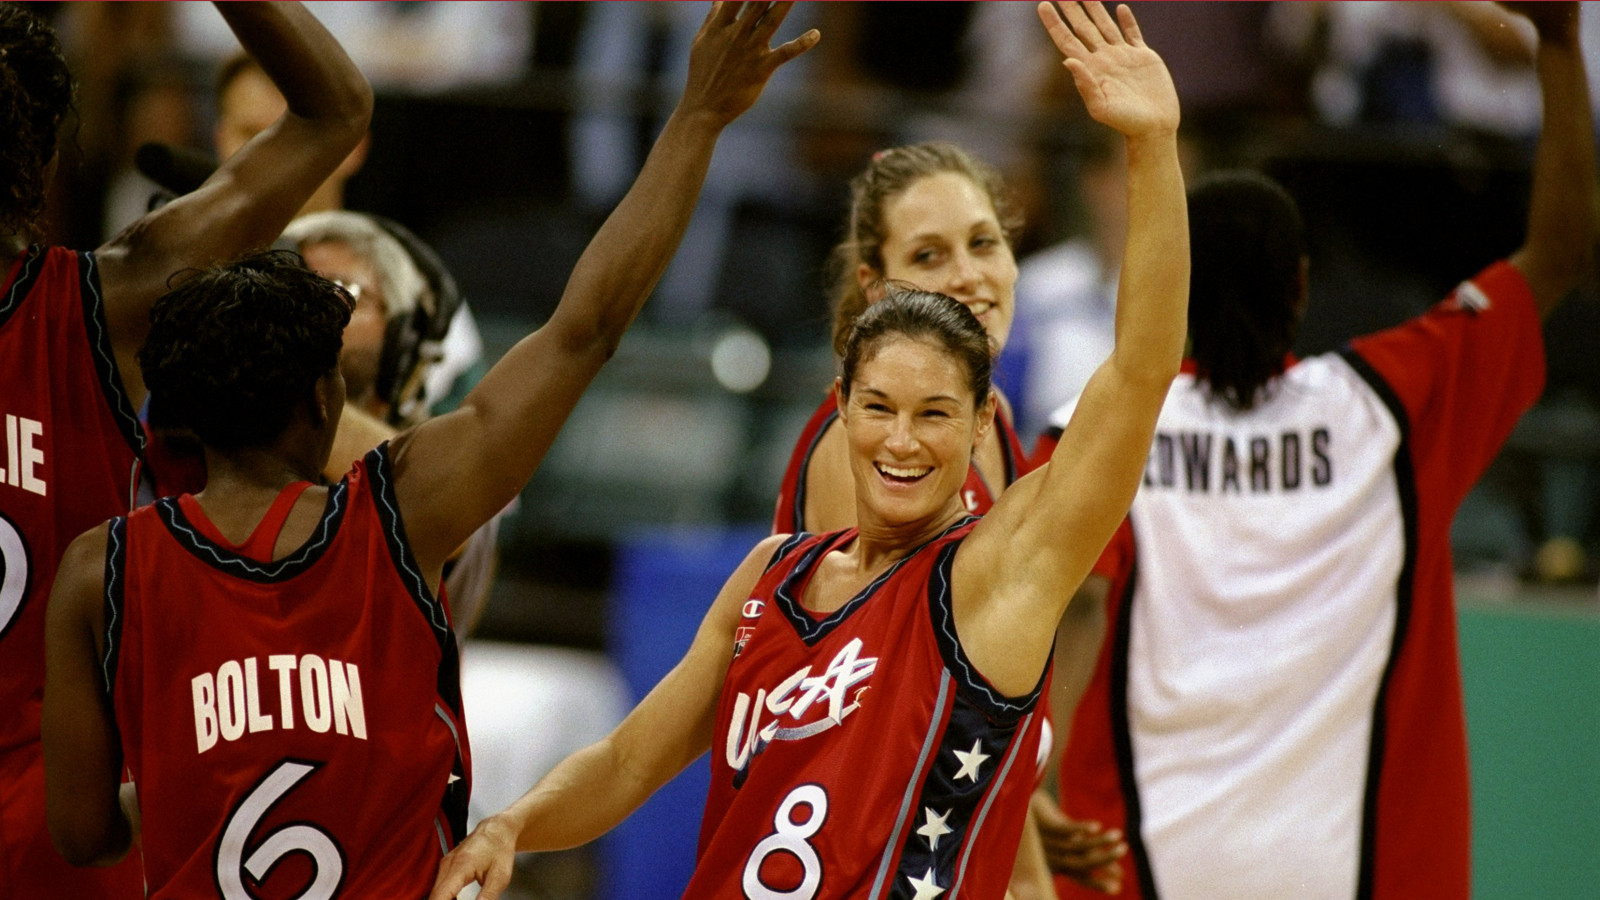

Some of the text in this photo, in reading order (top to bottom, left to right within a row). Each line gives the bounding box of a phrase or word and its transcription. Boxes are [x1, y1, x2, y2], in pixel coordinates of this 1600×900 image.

[0, 413, 47, 497] IE
[191, 653, 368, 754] BOLTON
[726, 637, 879, 771] USA
[216, 761, 344, 900] 6
[741, 784, 828, 900] 8
